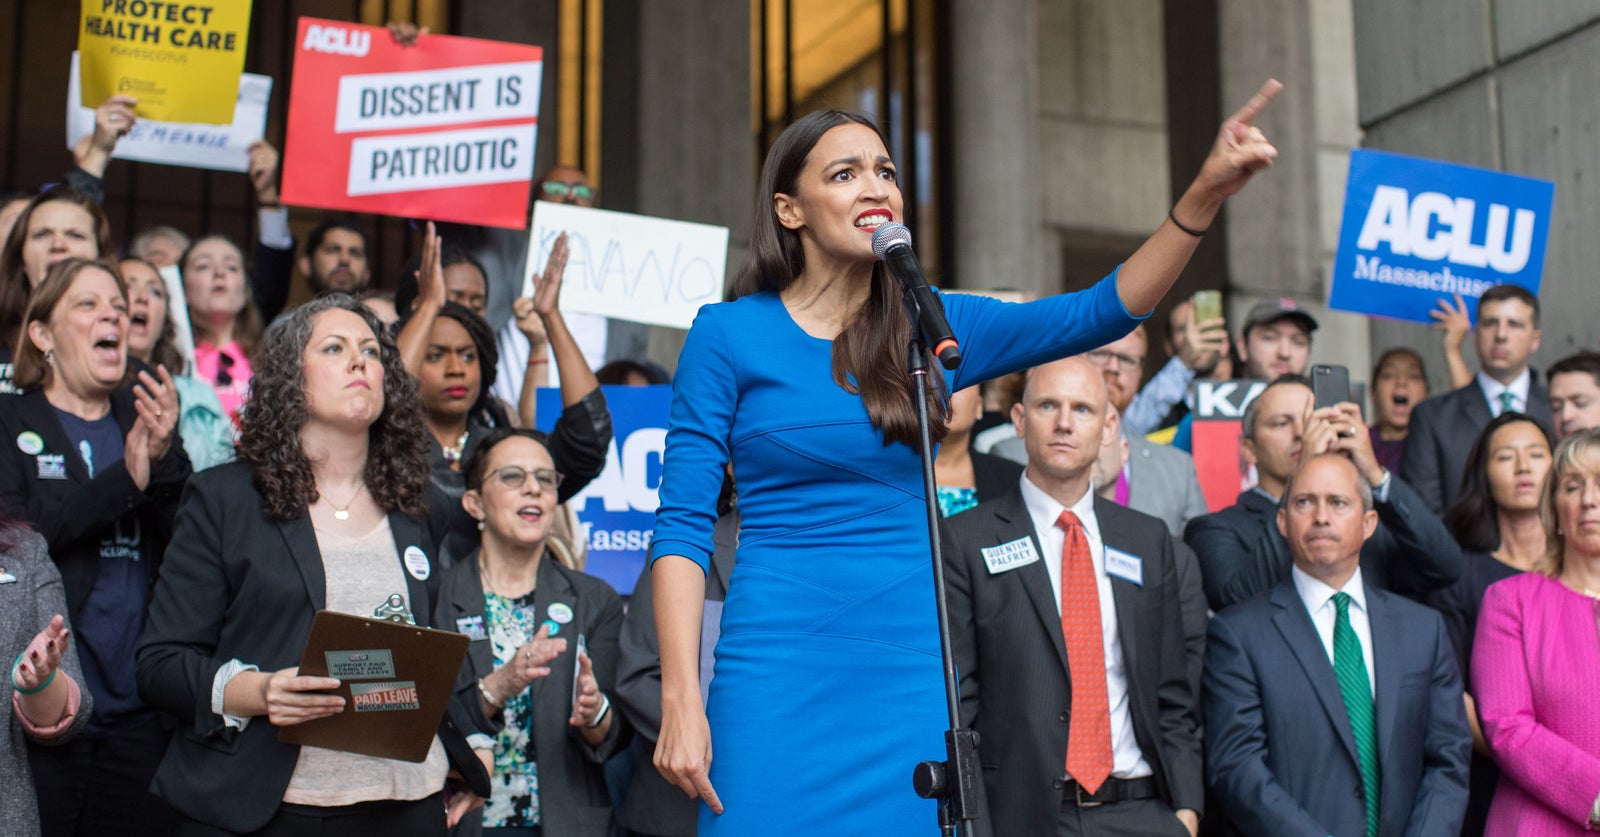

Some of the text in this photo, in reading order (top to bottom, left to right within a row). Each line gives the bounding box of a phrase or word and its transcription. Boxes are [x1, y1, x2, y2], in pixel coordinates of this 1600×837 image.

[102, 0, 213, 25] PROTECT
[85, 16, 237, 51] HEALTH CARE
[303, 24, 371, 57] ACLU
[359, 75, 522, 119] DISSENT IS
[370, 138, 518, 181] PATRIOTIC
[1356, 184, 1536, 275] ACLU
[986, 540, 1028, 558] QUENTIN
[990, 550, 1031, 567] PALFREY
[354, 687, 418, 706] PAID LEAVE
[356, 702, 416, 711] MASSACHUSETTS
